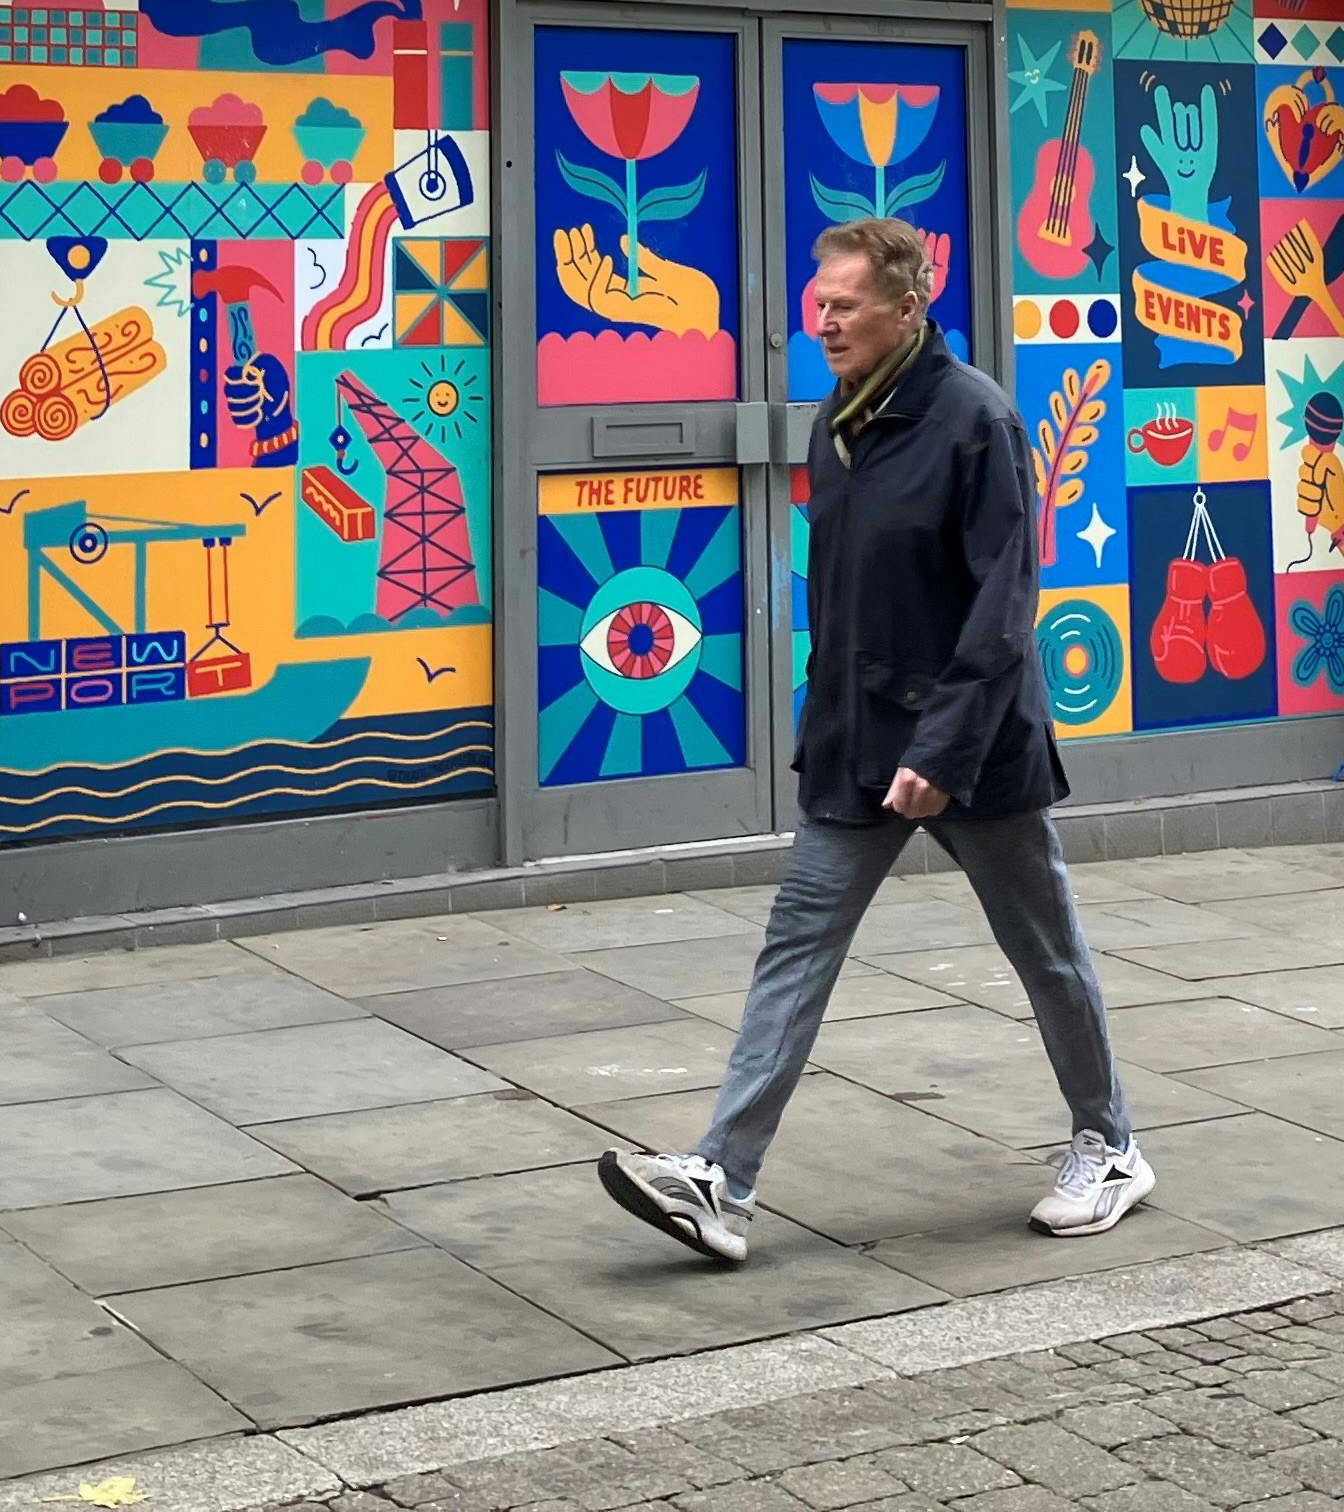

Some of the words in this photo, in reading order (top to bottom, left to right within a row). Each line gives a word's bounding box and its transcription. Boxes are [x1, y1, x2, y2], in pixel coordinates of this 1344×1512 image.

[1144, 289, 1231, 341] EVENTS
[575, 479, 615, 507] THE
[623, 474, 705, 505] FUTURE
[9, 639, 178, 673] NEW
[8, 660, 244, 711] PORT
